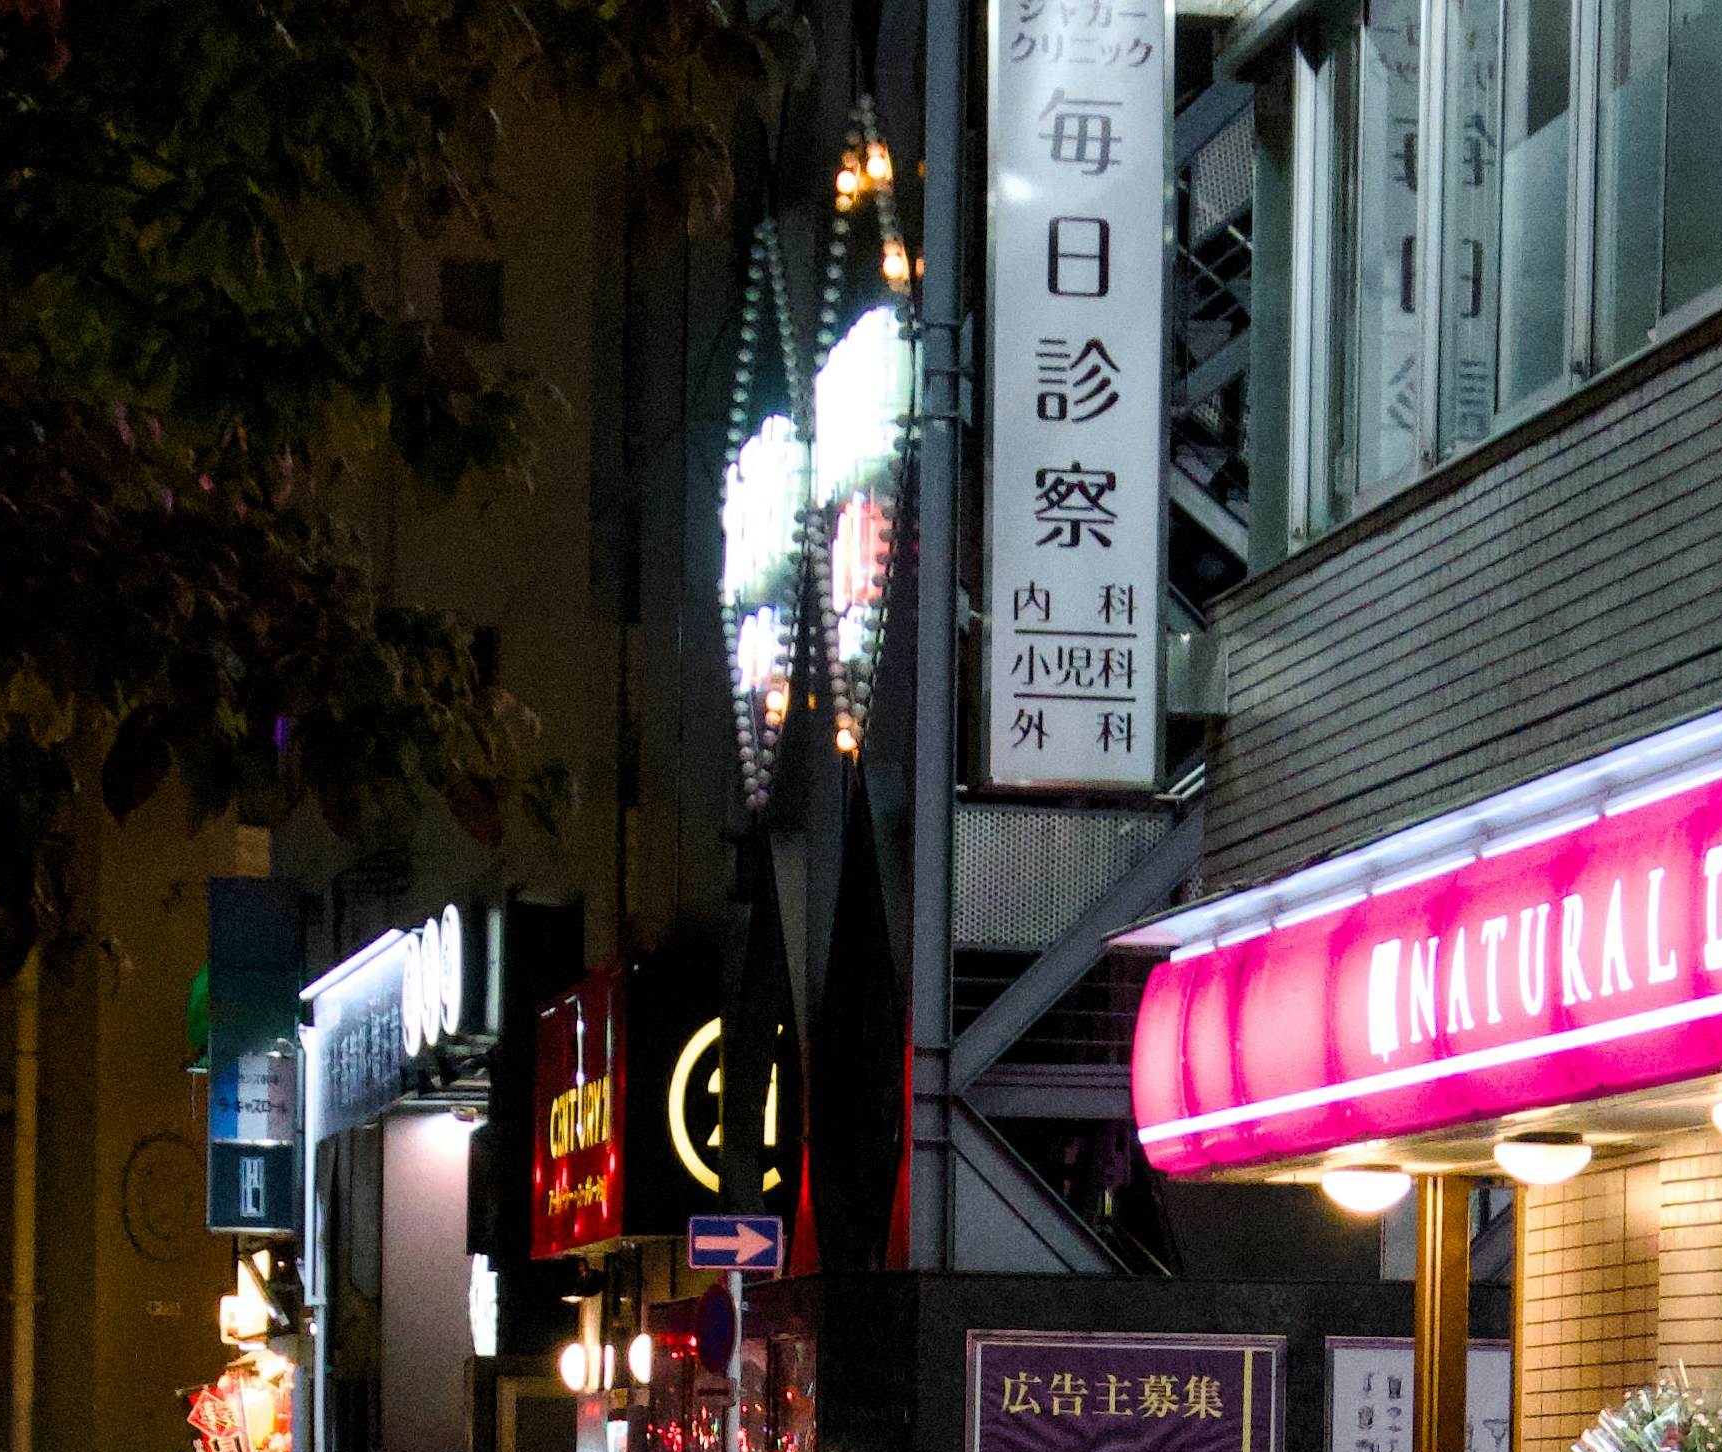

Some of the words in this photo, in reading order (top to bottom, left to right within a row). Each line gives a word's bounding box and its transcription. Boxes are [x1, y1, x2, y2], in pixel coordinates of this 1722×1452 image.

[1010, 32, 1153, 67] クリニック
[1035, 87, 1124, 549] 毎日診察
[1013, 579, 1138, 625] 内科
[1010, 645, 1137, 689] 小児科
[1010, 708, 1136, 753] 外科
[1410, 866, 1678, 1044] NATURAL
[1001, 1371, 1224, 1420] 広告主募集
